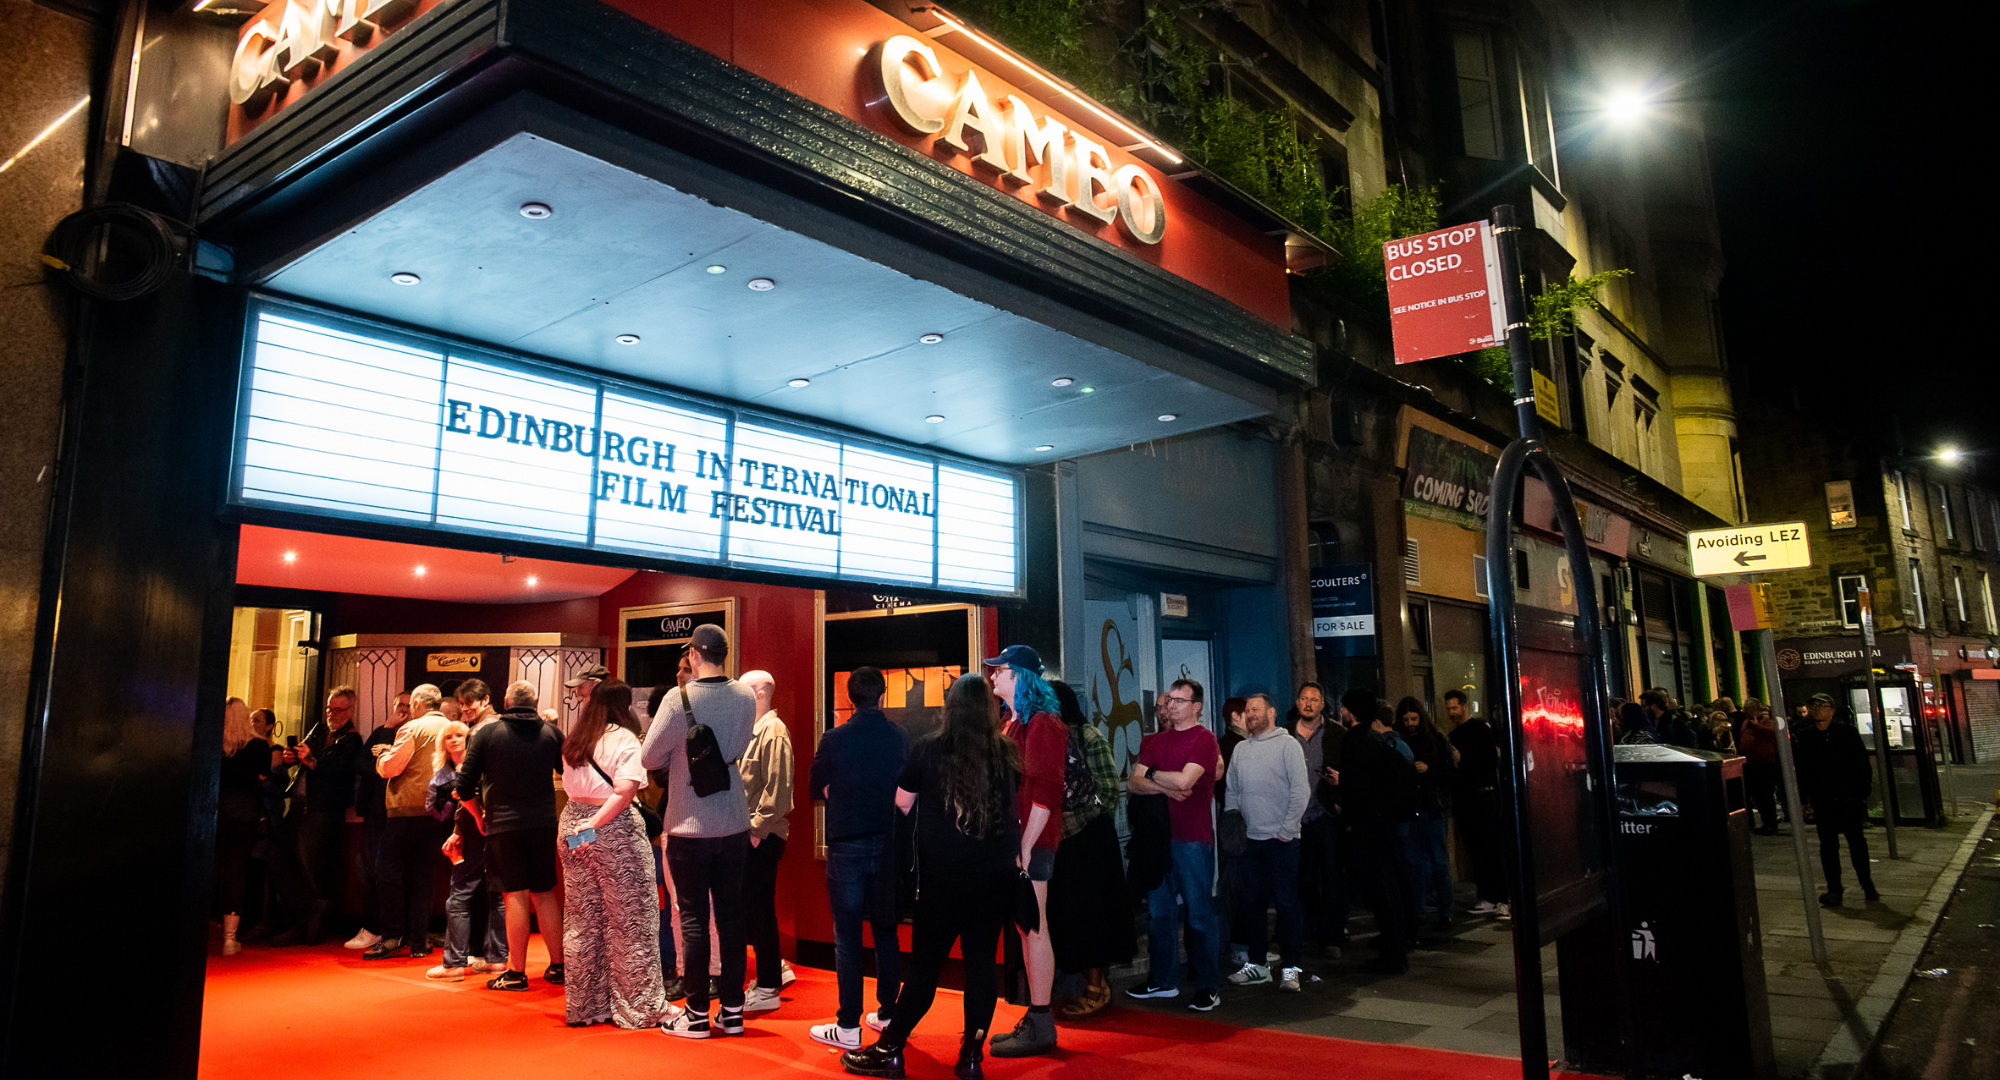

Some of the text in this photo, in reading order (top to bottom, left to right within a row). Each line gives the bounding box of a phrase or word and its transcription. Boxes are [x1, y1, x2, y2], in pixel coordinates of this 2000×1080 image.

[880, 34, 1166, 245] CAMEO
[1387, 227, 1476, 261] BUS STOP
[1389, 253, 1462, 281] CLOSED
[1393, 289, 1486, 315] SEE NOTICE IN BUS STOP
[446, 398, 937, 518] EDINBURGH INTERNATIONAL
[597, 469, 842, 536] FILM FESTIVAL
[1413, 474, 1465, 508] COMING
[1696, 529, 1801, 549] Avoiding LEZ
[1310, 576, 1361, 588] COULTERS
[660, 616, 692, 634] CAMEO
[1316, 620, 1365, 632] FOR SALE
[438, 655, 469, 667] Cameo
[1802, 649, 1882, 661] EDINBURGH TAI
[1620, 820, 1652, 834] itter
